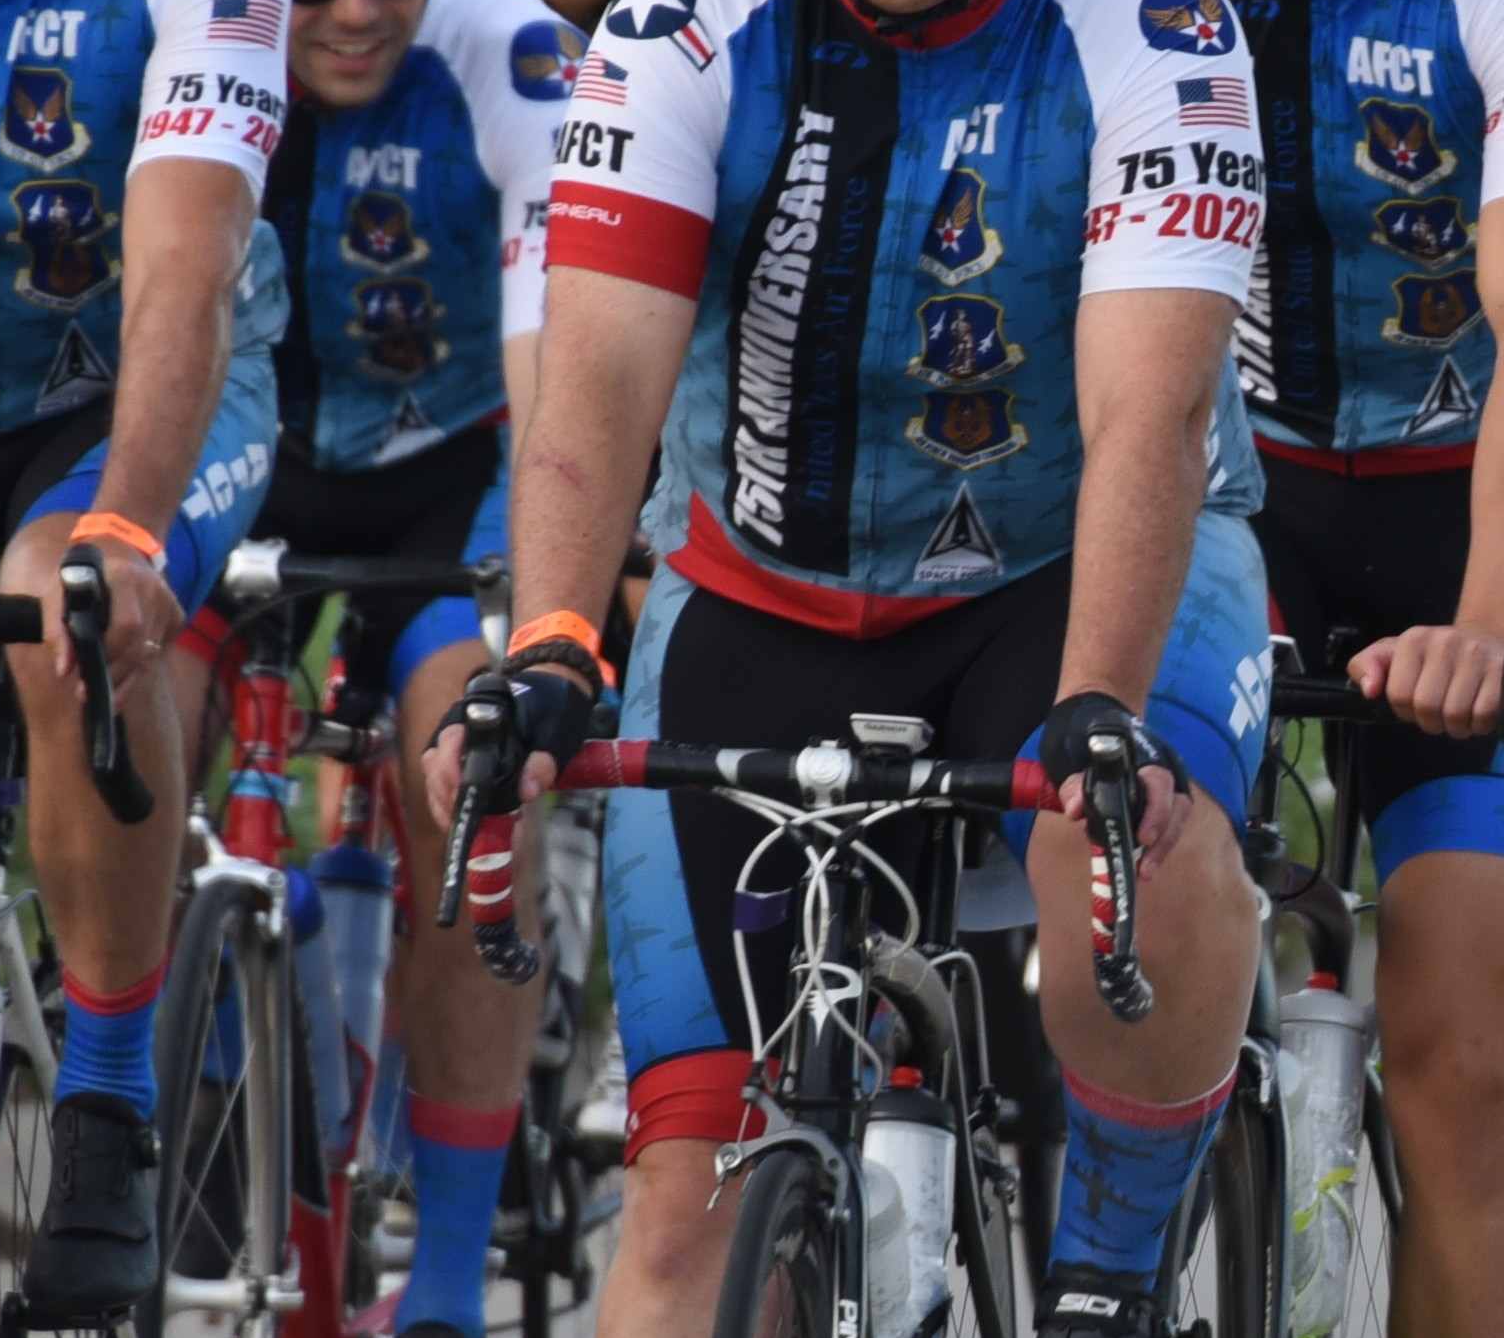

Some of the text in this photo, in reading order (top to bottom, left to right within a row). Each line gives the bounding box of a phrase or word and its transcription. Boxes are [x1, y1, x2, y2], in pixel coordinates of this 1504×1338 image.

[165, 72, 205, 105] 75
[1346, 35, 1435, 97] AFCT
[139, 107, 217, 144] 1947
[241, 114, 282, 157] 20
[1117, 146, 1175, 195] 75
[821, 178, 868, 276] Force
[1157, 193, 1260, 249] 2022
[732, 104, 835, 547] 75TH ANNIVERSARY
[1054, 1293, 1122, 1319] SIDI
